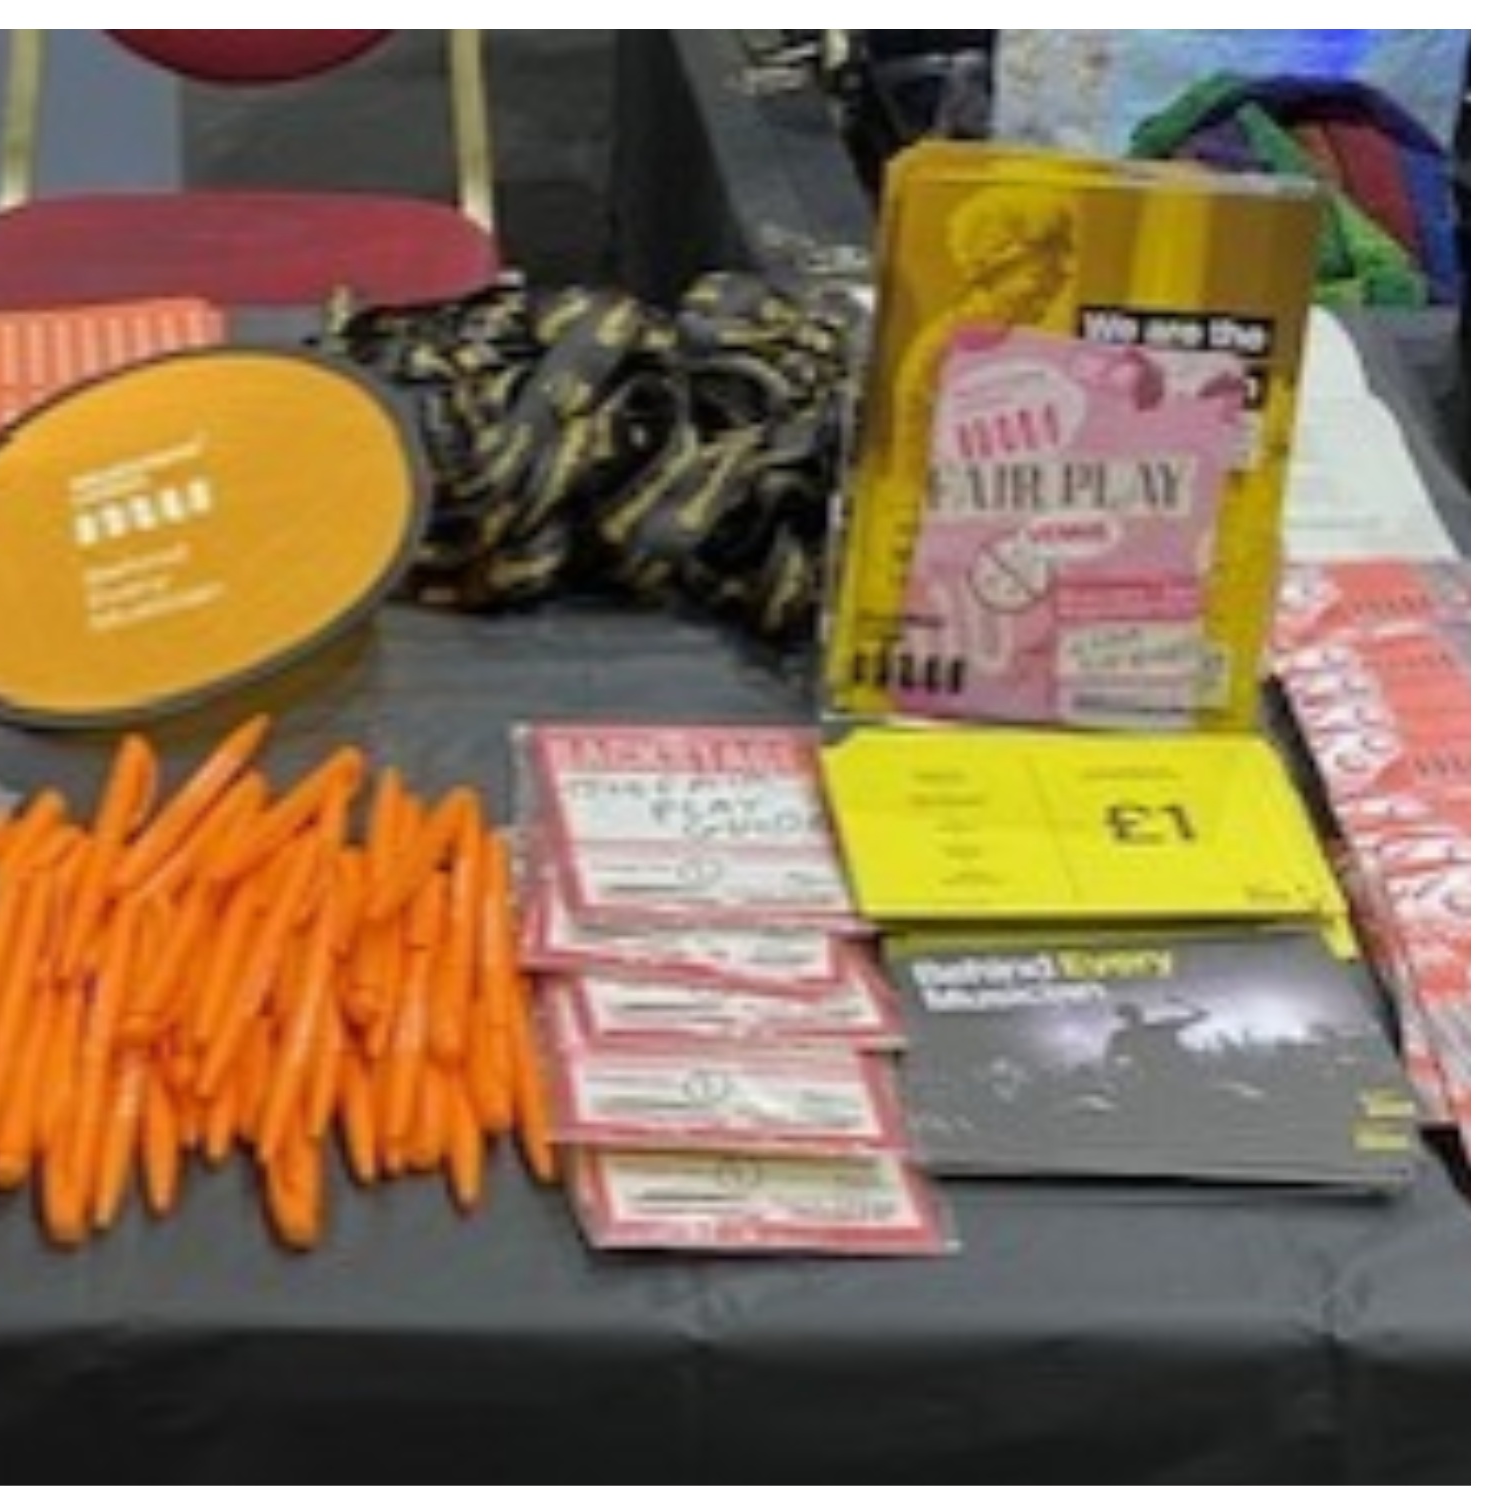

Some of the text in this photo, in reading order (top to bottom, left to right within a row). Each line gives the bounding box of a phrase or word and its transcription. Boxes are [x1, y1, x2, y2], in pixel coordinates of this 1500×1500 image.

[927, 463, 1186, 510] FAIR PLAY
[1105, 804, 1199, 844] £1
